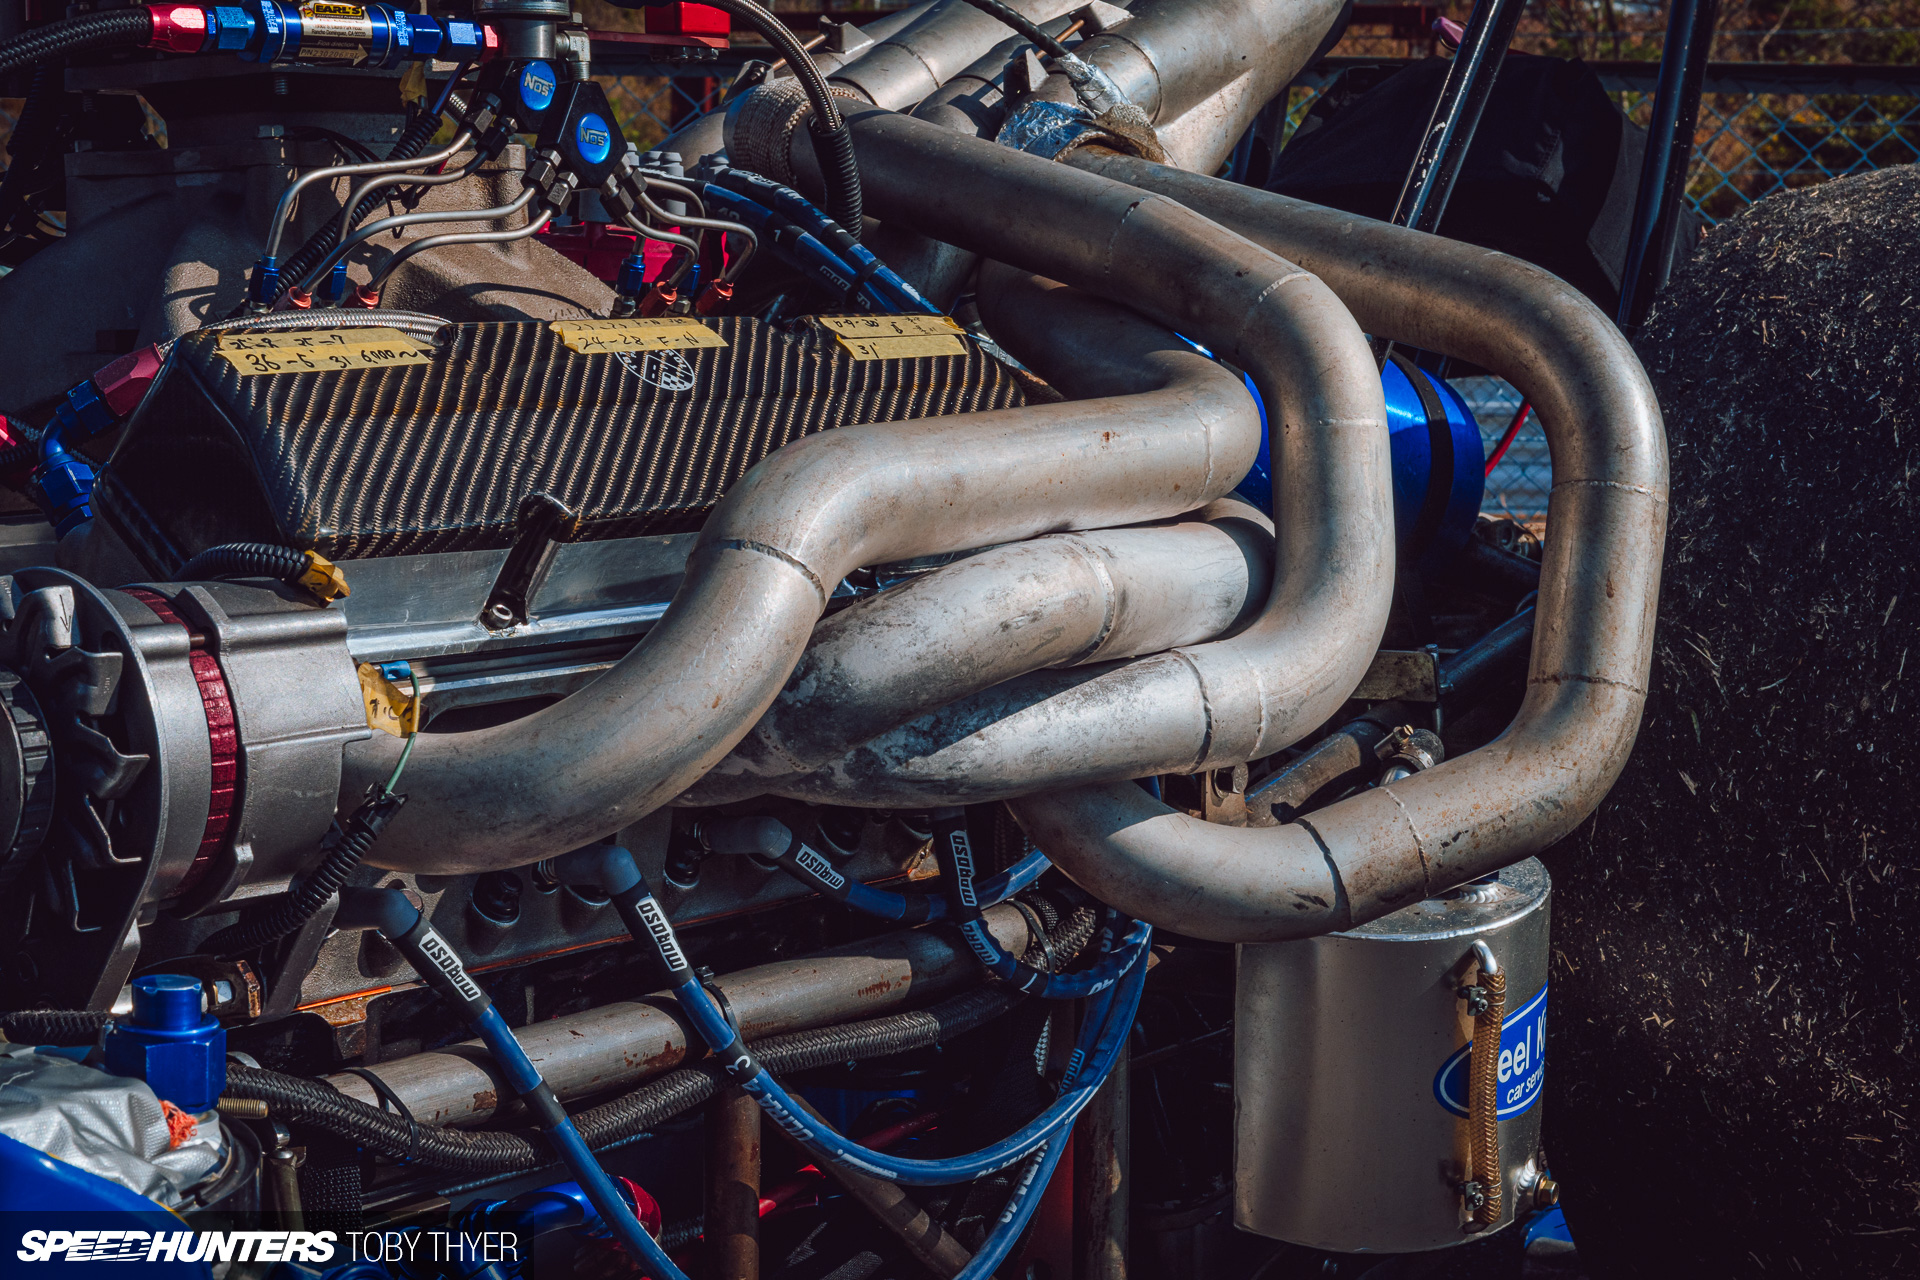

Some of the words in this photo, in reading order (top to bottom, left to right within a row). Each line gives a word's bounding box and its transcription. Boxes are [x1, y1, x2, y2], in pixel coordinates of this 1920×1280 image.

[316, 5, 361, 15] EARL'S
[524, 72, 554, 97] NOS
[580, 127, 608, 147] NOS
[796, 842, 845, 890] MOROSO
[950, 829, 978, 907] MOROSO
[635, 892, 688, 972] MOROSO
[960, 919, 1001, 966] MORO
[418, 927, 482, 1002] MOROSO
[725, 1055, 751, 1076] 3
[757, 1092, 815, 1142] ULTRA
[1506, 1082, 1525, 1105] car
